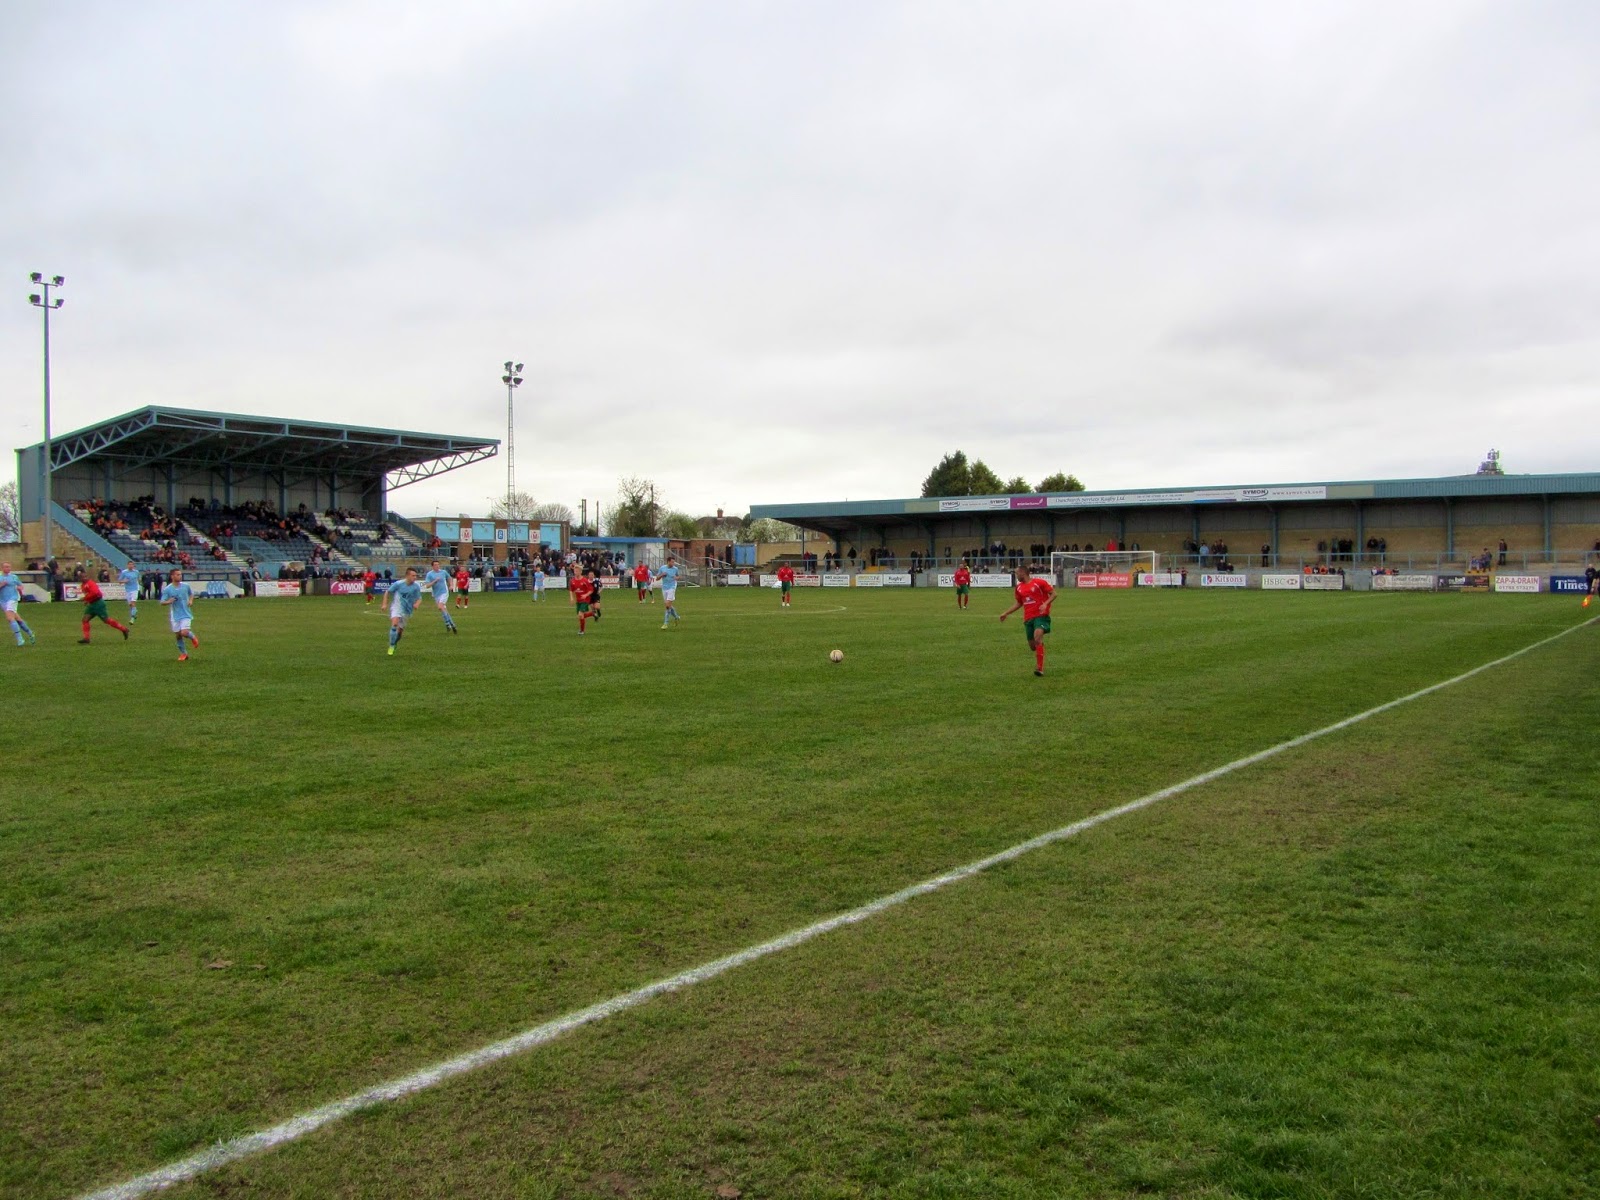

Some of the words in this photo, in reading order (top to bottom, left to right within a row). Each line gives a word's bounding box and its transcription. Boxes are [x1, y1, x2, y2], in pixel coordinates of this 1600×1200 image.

[1214, 575, 1243, 583] Kitsons
[1263, 578, 1285, 586] HSBC
[338, 582, 365, 591] SYMON
[1555, 579, 1589, 590] Times
